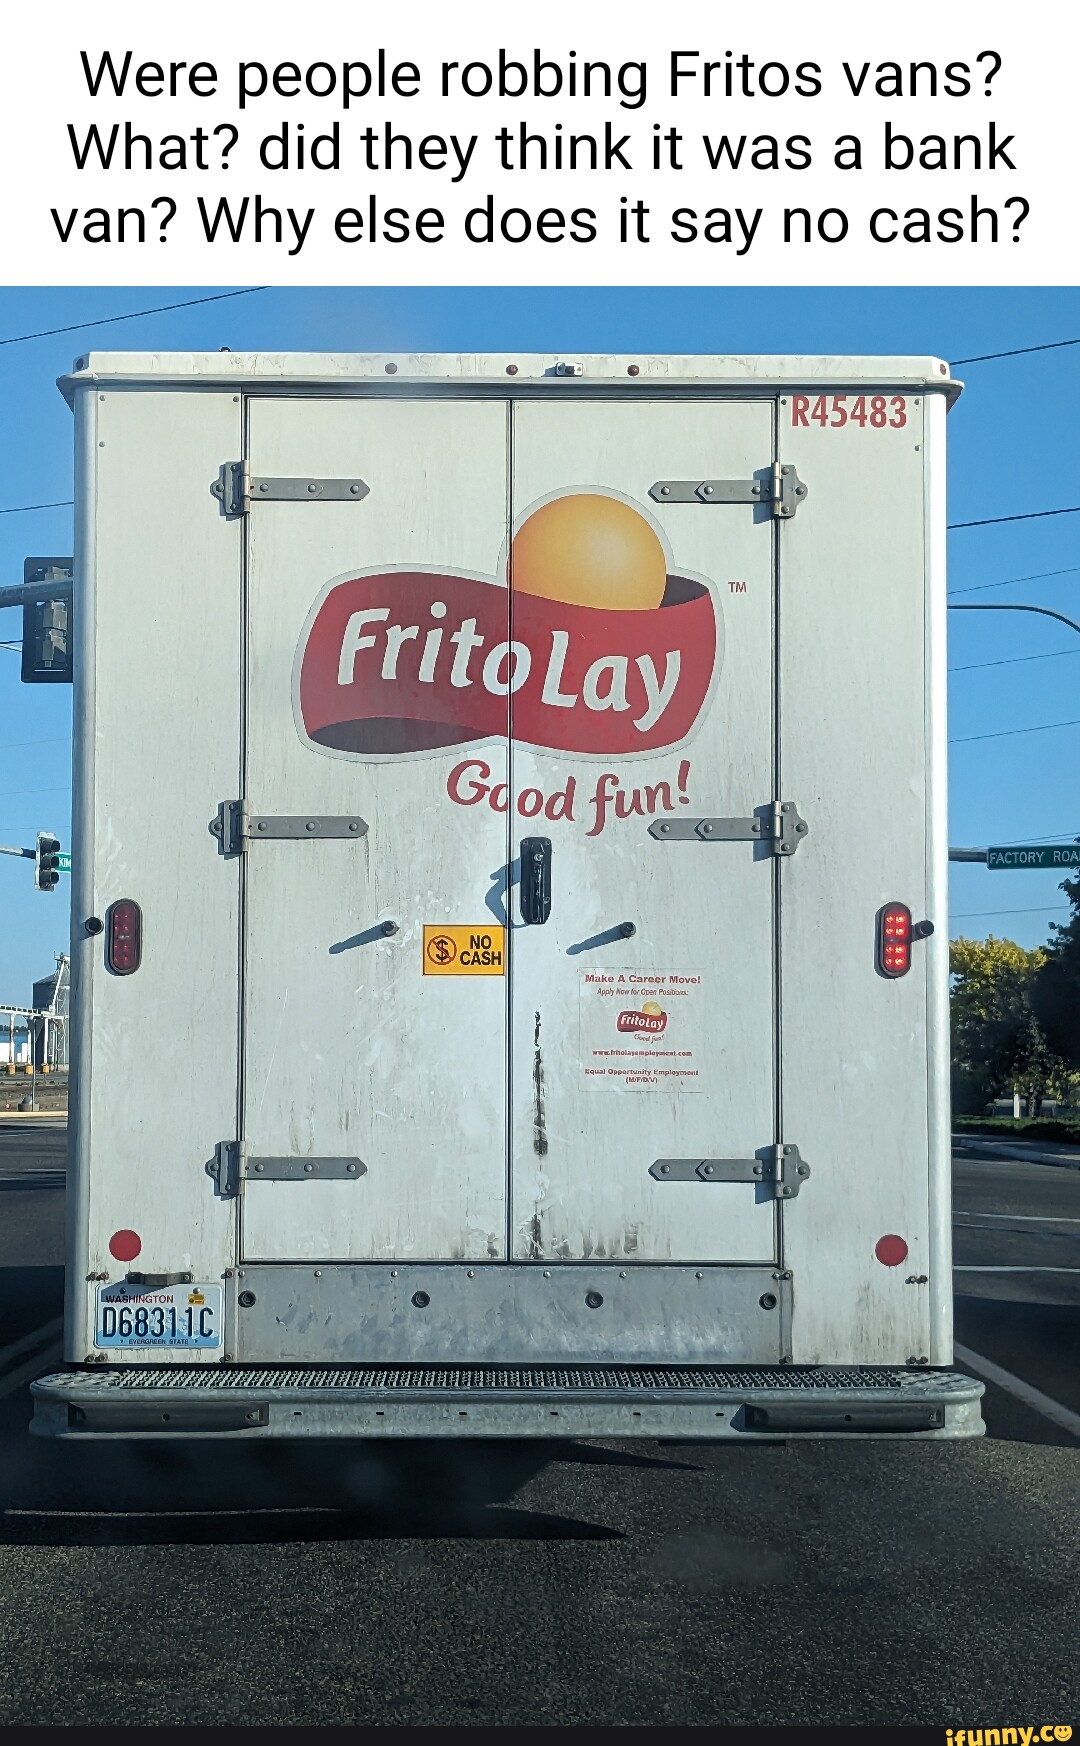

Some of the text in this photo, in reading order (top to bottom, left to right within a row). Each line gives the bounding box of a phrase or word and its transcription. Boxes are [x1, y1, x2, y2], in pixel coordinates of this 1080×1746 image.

[791, 395, 907, 428] R45483
[728, 581, 746, 592] TM
[447, 759, 691, 836] Good fun!
[989, 850, 1080, 864] FACTORY ROA
[469, 934, 492, 950] NO
[459, 950, 502, 966] CASH
[584, 974, 701, 984] Make A Career Move!
[597, 987, 615, 996] Apply
[615, 987, 629, 995] Now
[630, 987, 640, 995] for
[640, 988, 657, 996] Open
[634, 1033, 665, 1044] Good fun!
[592, 1049, 693, 1057] www.fritolayemployment.com
[585, 1068, 699, 1077] Equal Opportunity Employment
[105, 1294, 174, 1304] WASHINGTON
[102, 1306, 214, 1338] D68311C
